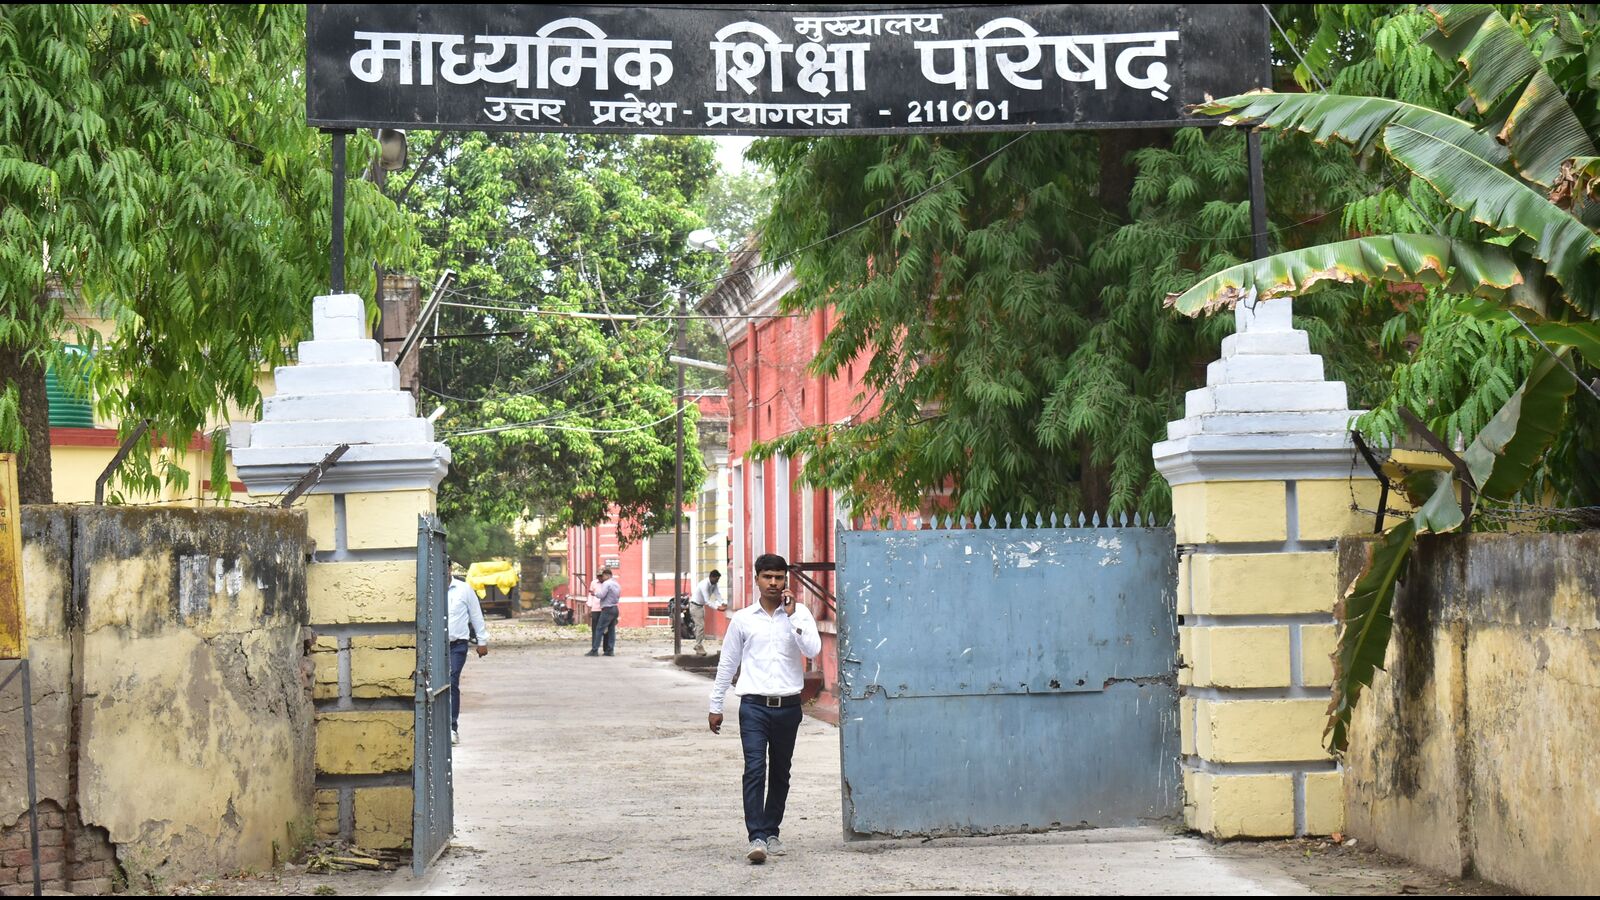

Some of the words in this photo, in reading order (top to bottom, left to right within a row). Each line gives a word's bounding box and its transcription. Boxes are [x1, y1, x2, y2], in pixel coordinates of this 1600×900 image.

[792, 13, 943, 43] मुख्यालय
[350, 17, 674, 91] माध्यमिक
[709, 20, 871, 98] शिक्षा
[913, 17, 1179, 101] परिषद्
[484, 96, 567, 123] उत्तर
[703, 101, 852, 127] प्रयागराज
[907, 99, 1010, 123] 211001
